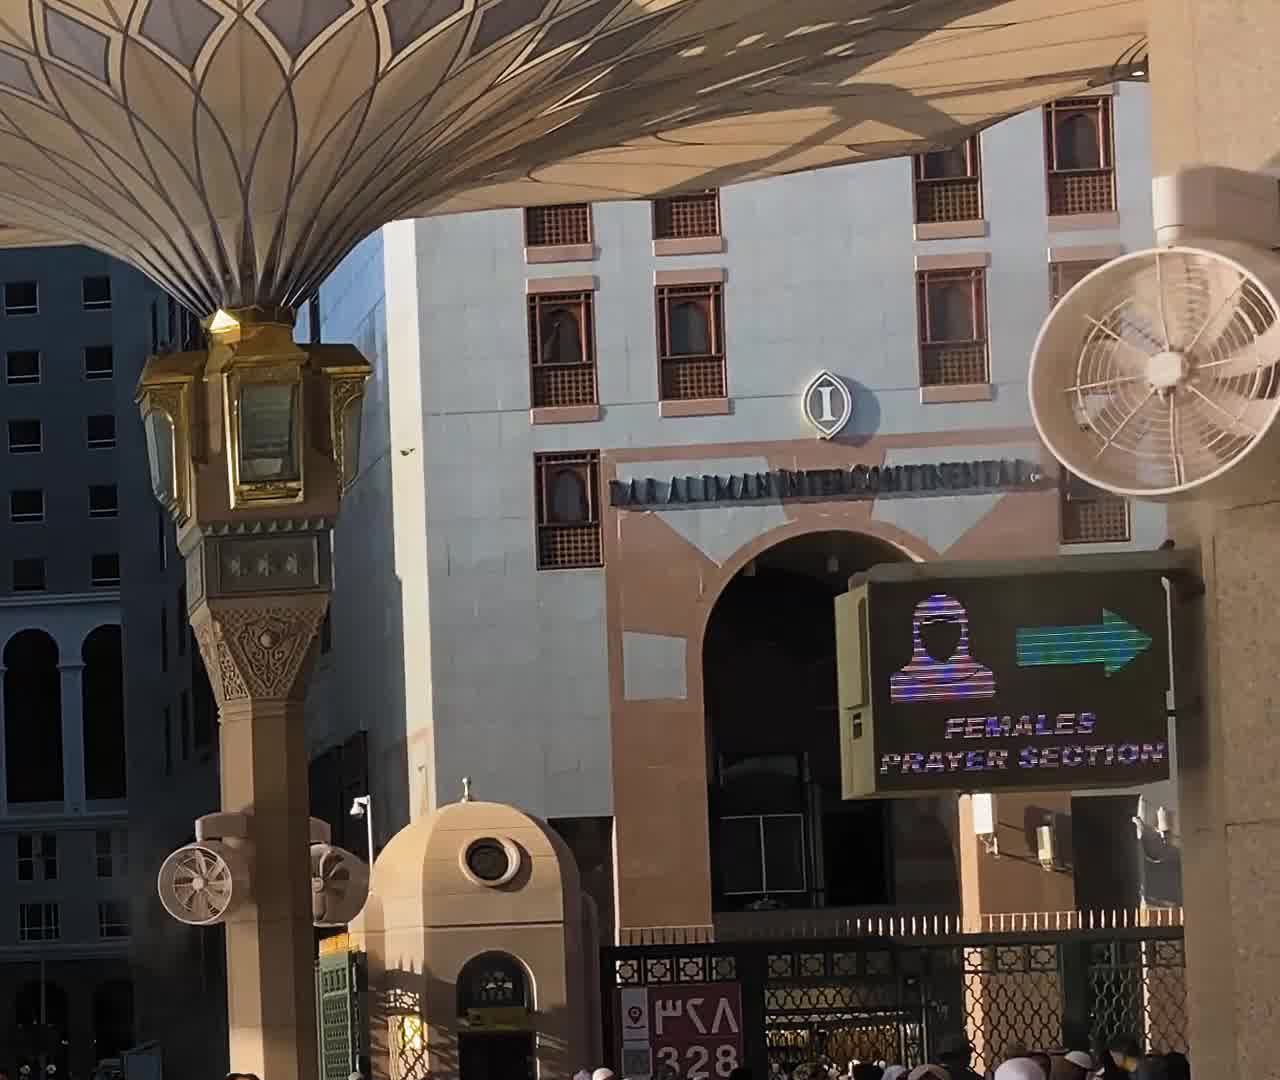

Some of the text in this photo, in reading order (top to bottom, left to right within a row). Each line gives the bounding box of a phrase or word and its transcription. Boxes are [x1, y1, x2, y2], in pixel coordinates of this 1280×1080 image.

[944, 712, 1096, 739] FEMALES
[880, 743, 1167, 774] PRAYER SECTION
[656, 997, 738, 1034] ٣٢٨
[657, 1045, 738, 1079] 328
